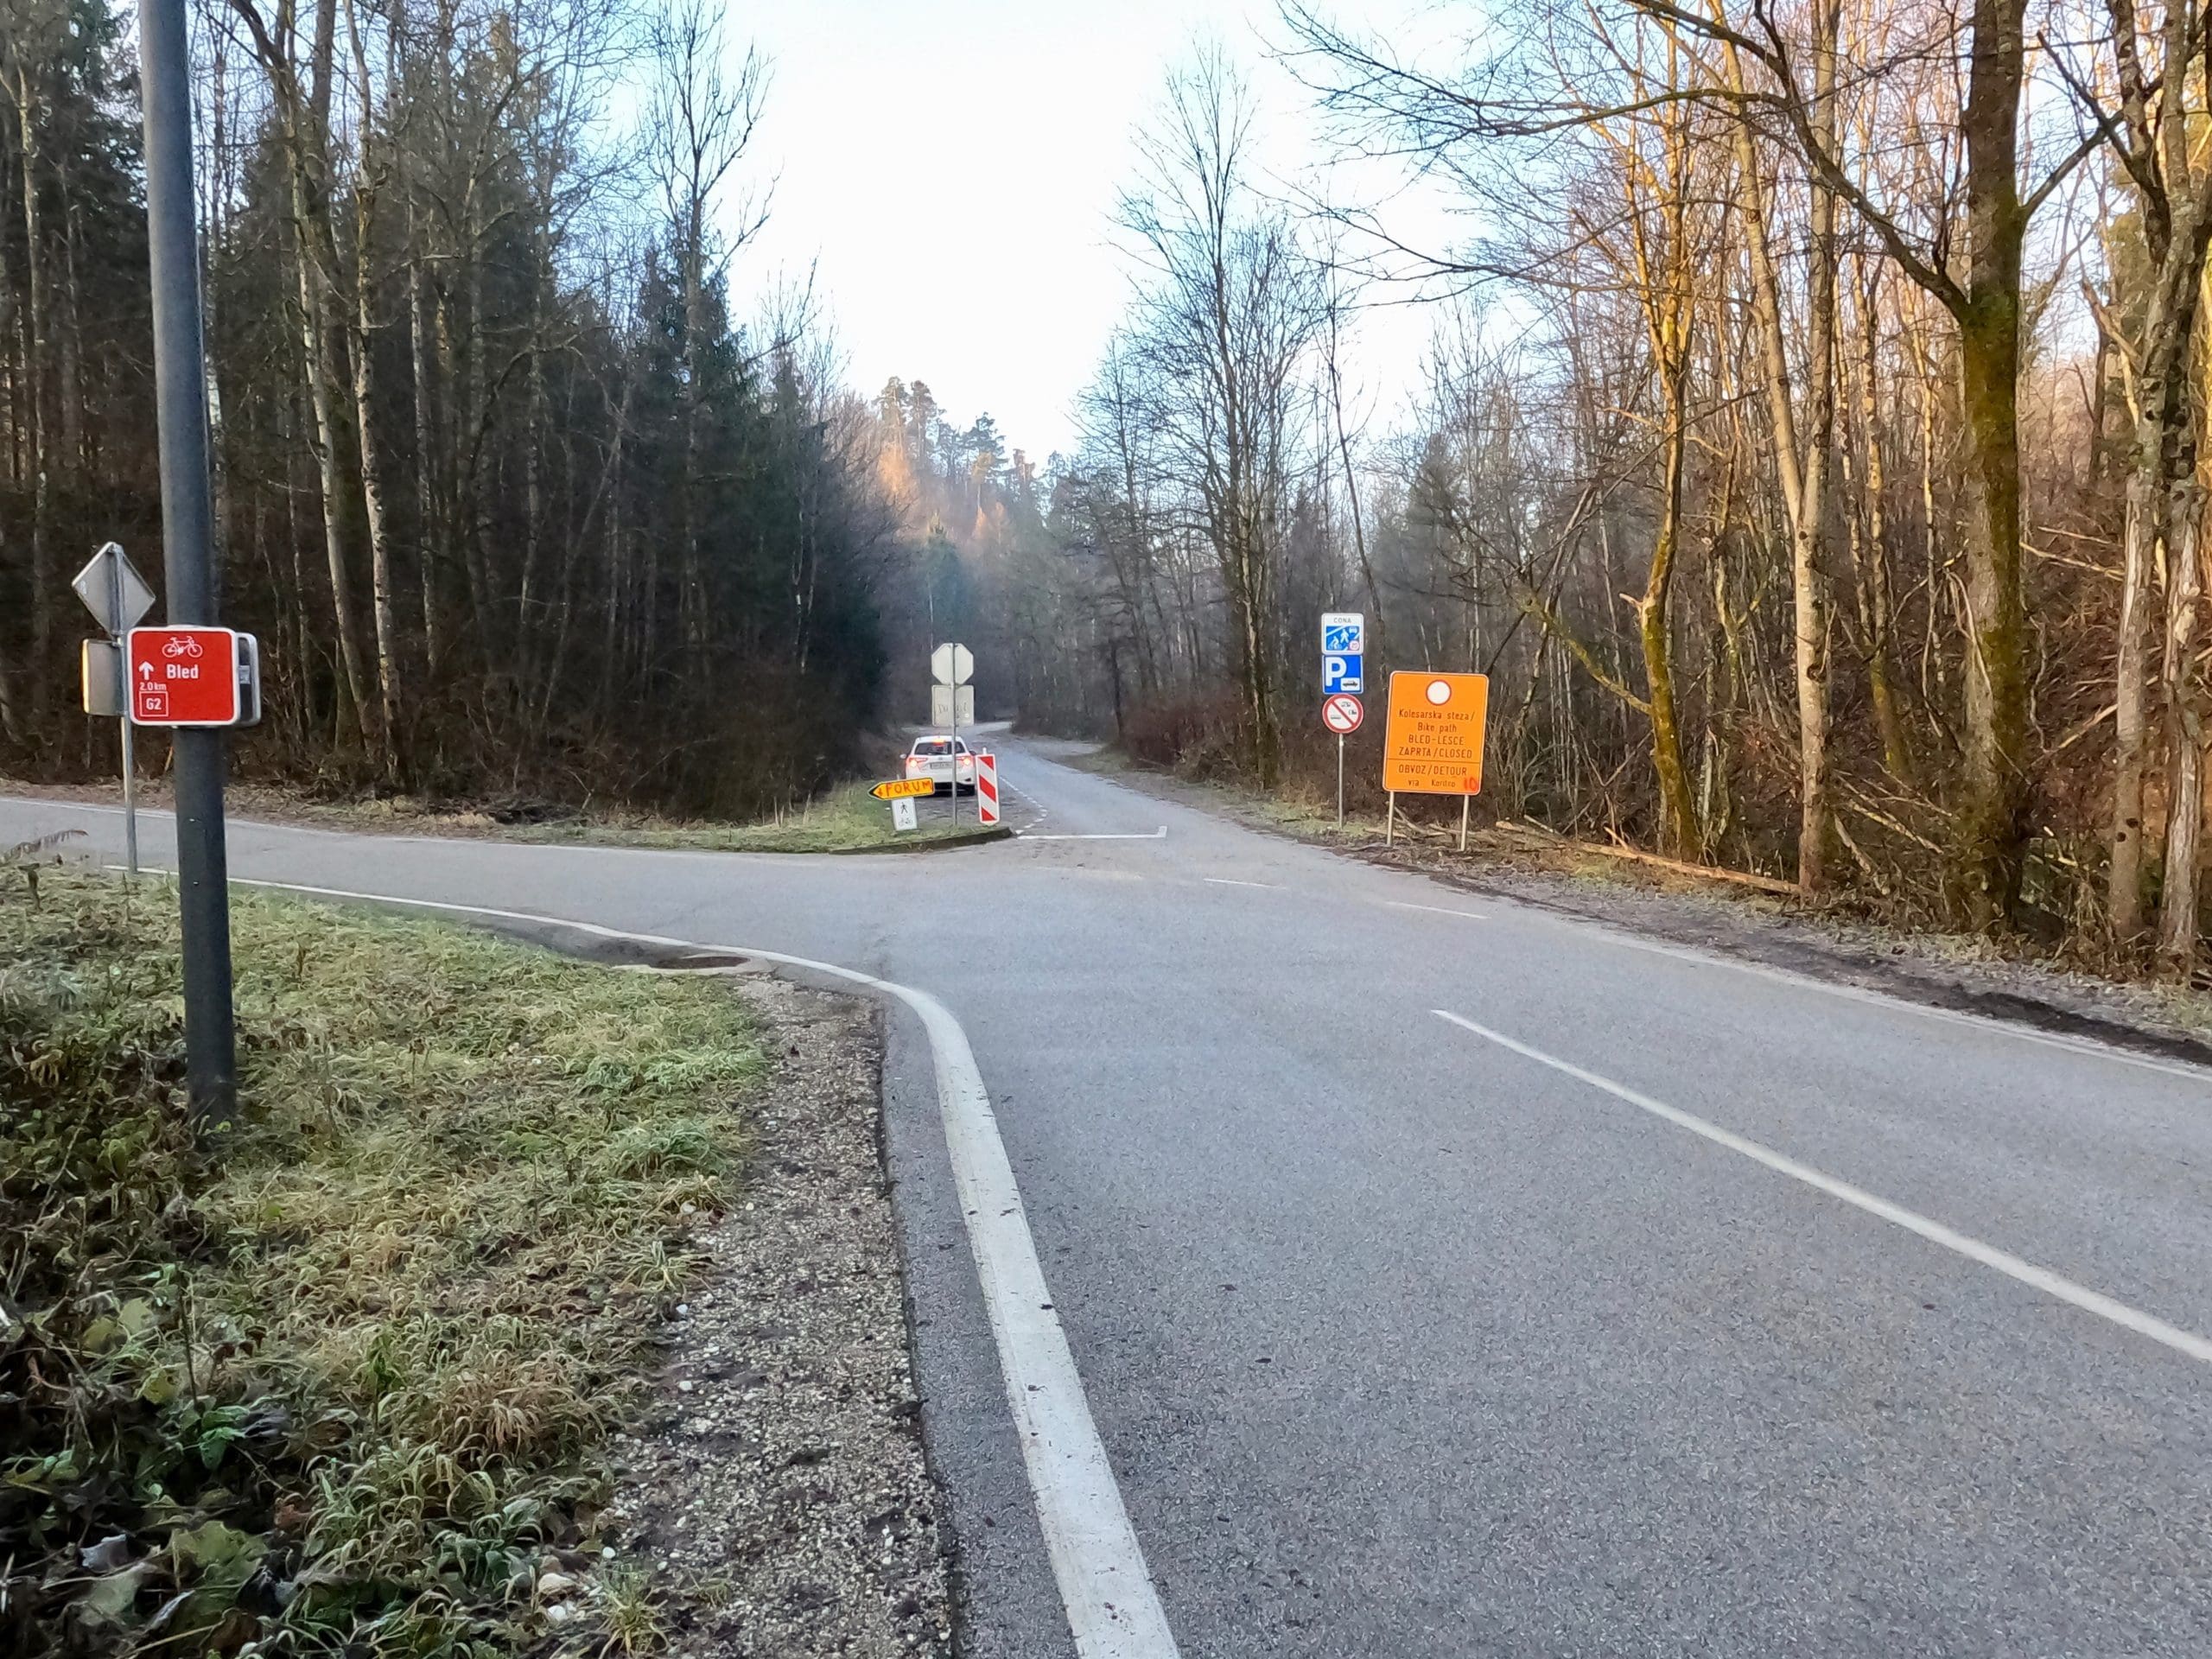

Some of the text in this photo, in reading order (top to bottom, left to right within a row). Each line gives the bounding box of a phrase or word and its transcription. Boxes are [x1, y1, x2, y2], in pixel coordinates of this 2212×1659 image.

[166, 664, 199, 679] Bled
[1325, 657, 1347, 687] P
[145, 698, 162, 710] G2
[1399, 709, 1442, 720] Kolesarska
[1417, 721, 1457, 734] Bike path
[886, 780, 932, 797] FORUM
